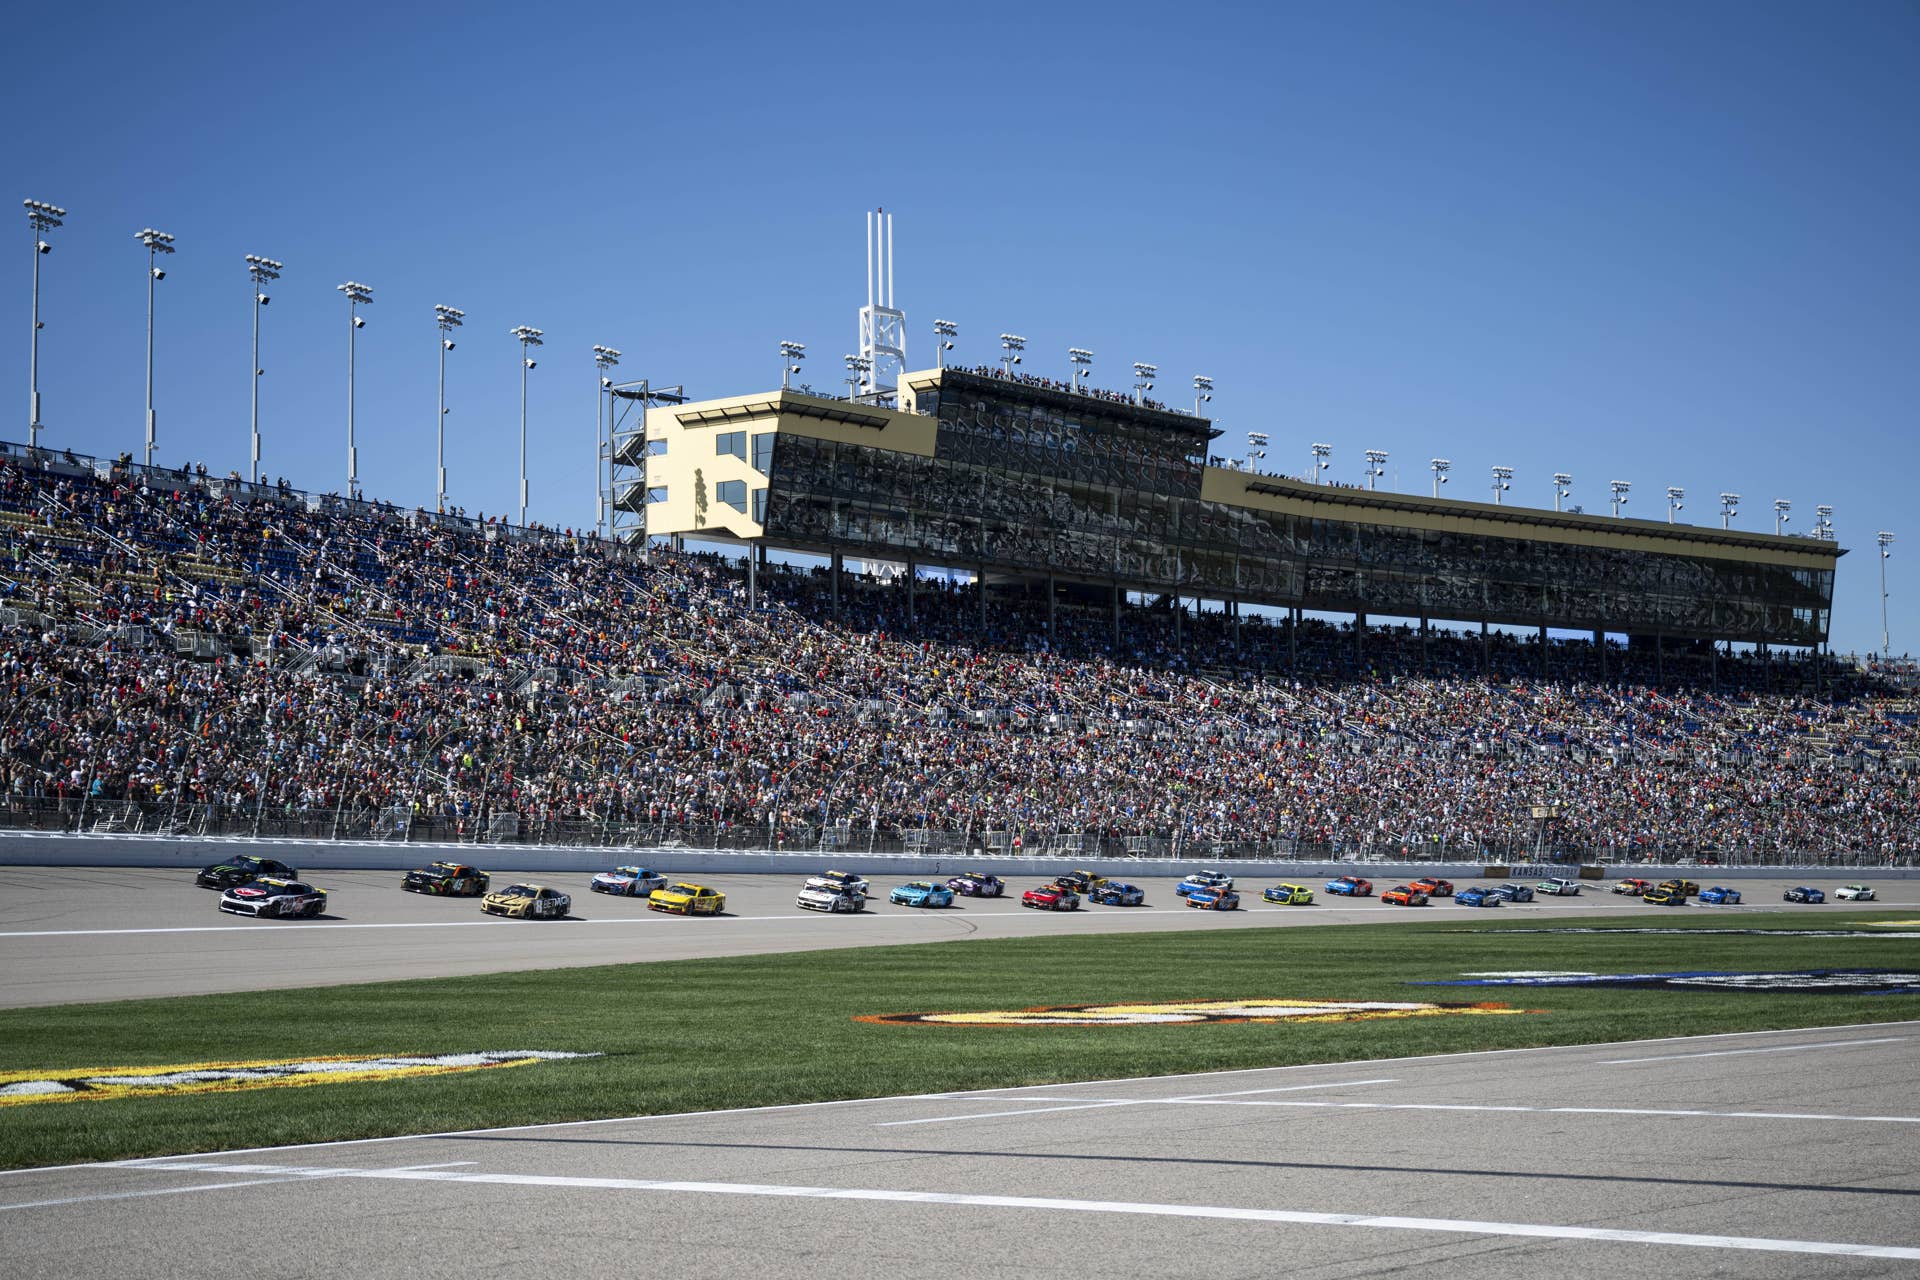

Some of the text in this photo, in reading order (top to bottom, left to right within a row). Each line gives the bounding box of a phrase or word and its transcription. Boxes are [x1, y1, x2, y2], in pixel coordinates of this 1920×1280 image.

[935, 862, 941, 873] 5
[1511, 866, 1578, 877] KANSAS SPEEDWAY
[536, 900, 543, 913] 8
